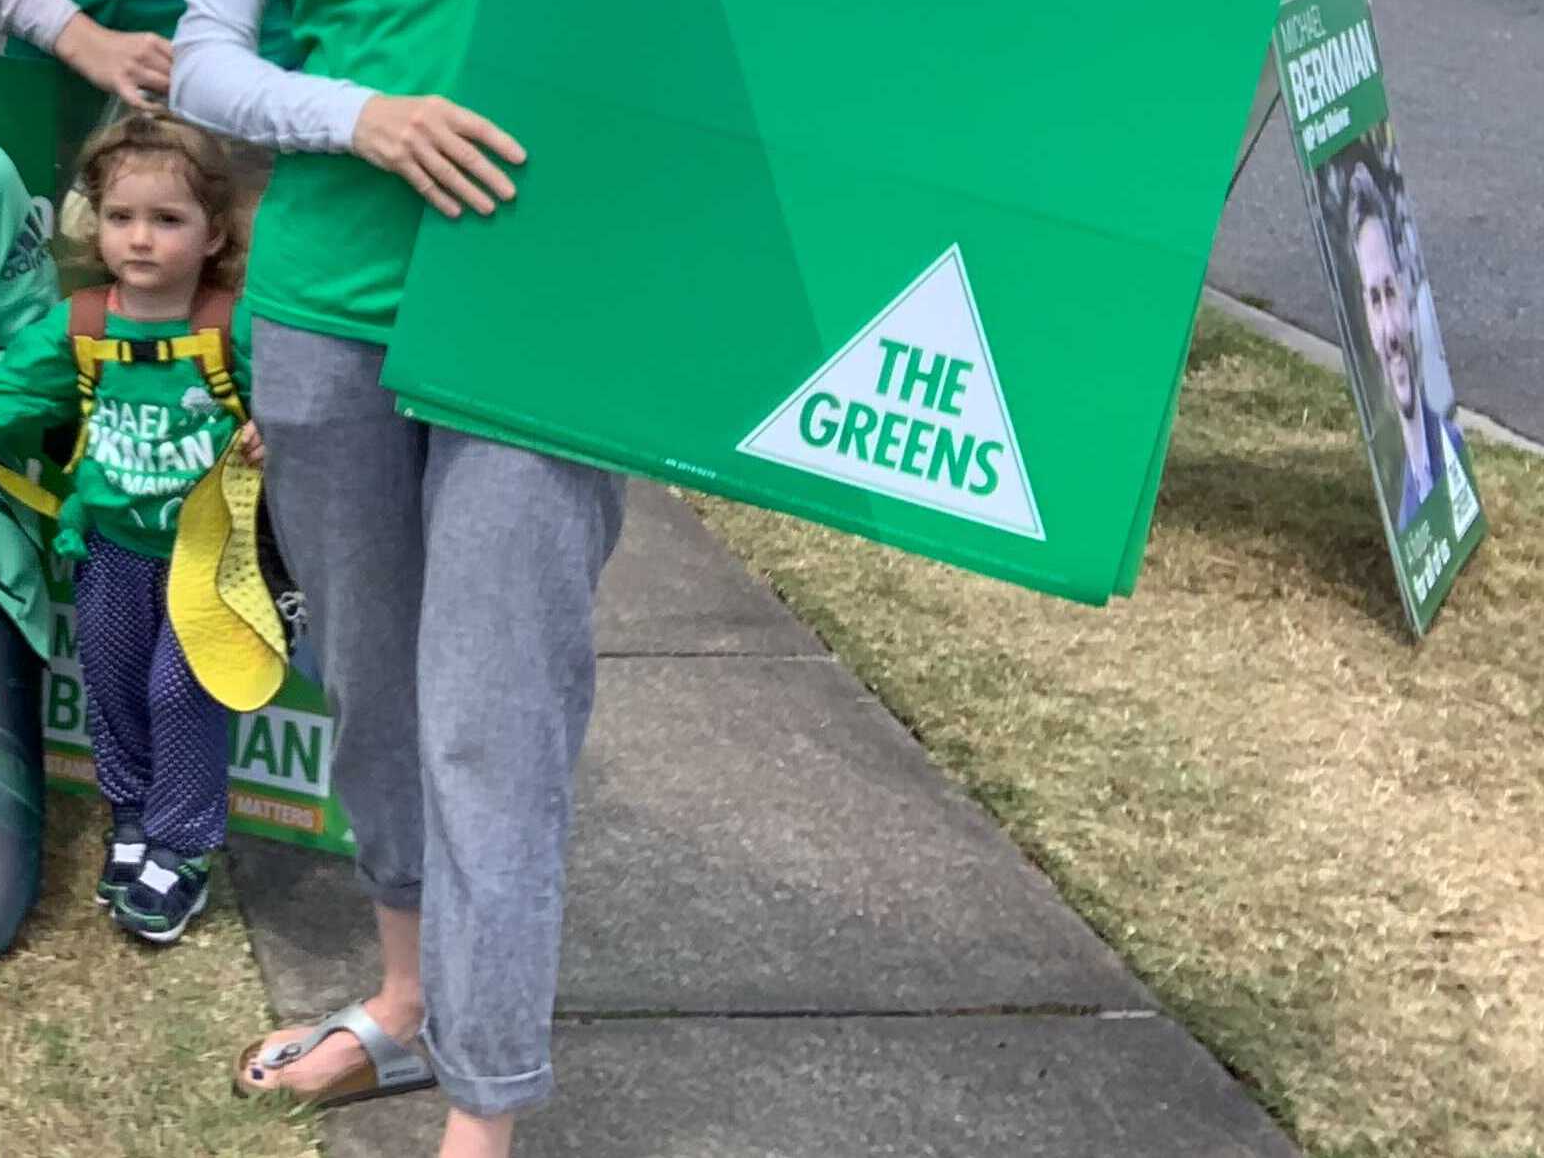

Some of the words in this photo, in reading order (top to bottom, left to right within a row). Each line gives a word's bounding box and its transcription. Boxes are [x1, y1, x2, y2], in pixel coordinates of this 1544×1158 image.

[1288, 19, 1378, 122] BERKMAN
[875, 338, 974, 418] THE
[798, 392, 1004, 498] GREENS
